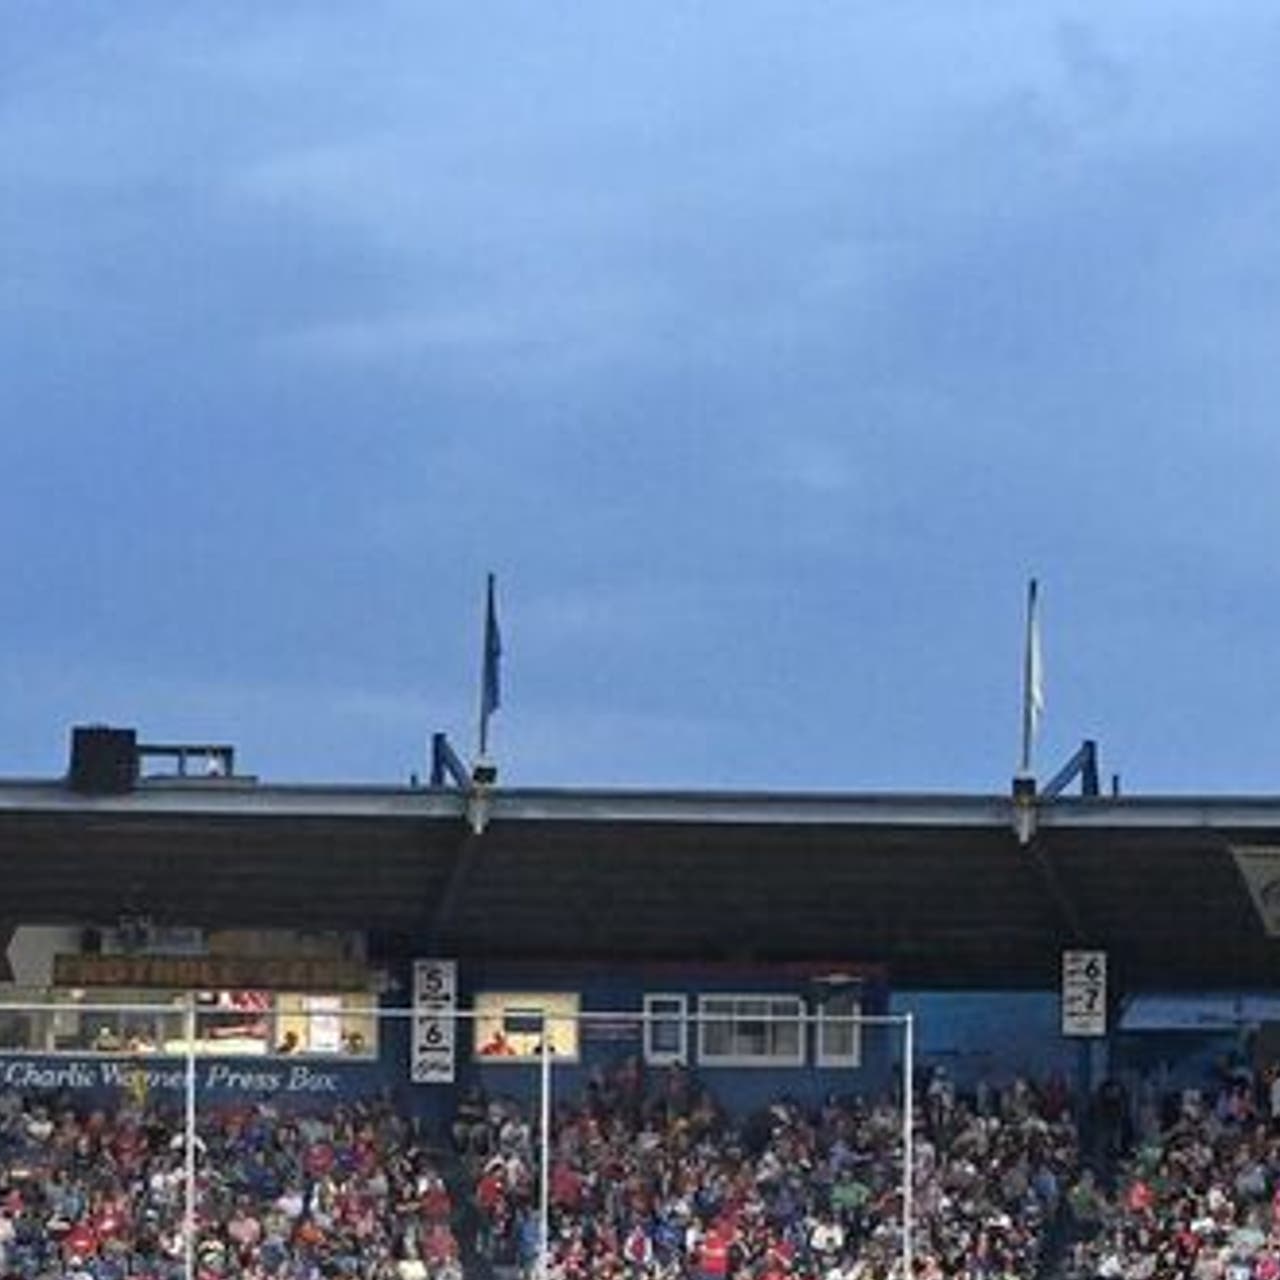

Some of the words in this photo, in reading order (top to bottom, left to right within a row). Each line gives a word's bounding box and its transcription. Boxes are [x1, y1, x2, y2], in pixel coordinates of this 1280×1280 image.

[1085, 957, 1101, 980] 6
[424, 969, 443, 993] 5
[1084, 988, 1099, 1010] 7
[425, 1024, 443, 1045] 6
[5, 1062, 97, 1088] Charlie
[205, 1064, 281, 1091] Press
[286, 1066, 336, 1091] Box
